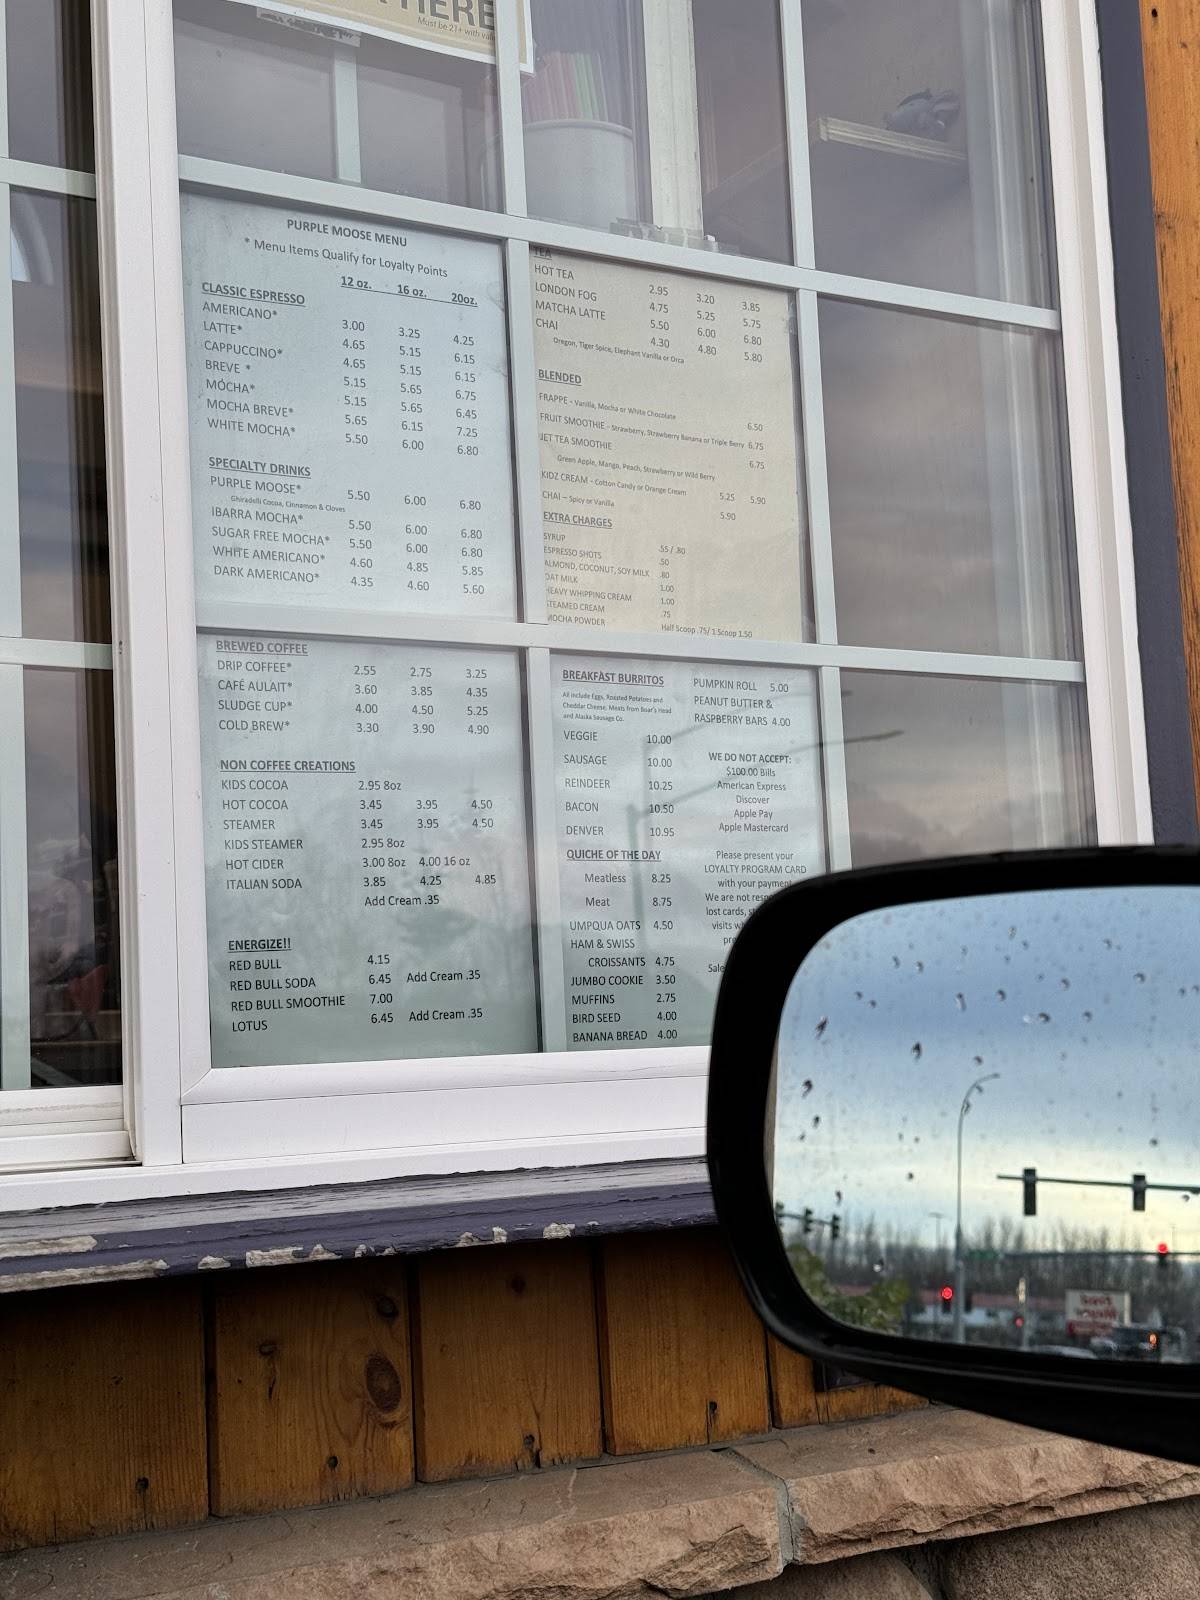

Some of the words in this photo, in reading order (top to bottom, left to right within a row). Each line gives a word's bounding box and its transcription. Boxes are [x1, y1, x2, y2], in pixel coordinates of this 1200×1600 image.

[286, 218, 329, 235] PURPLE
[330, 225, 372, 242] MOOSE
[374, 232, 407, 247] MENU
[253, 238, 286, 253] Menu
[288, 242, 319, 258] Items
[320, 247, 360, 266] Qualify
[360, 253, 377, 266] for
[378, 256, 415, 275] Loyalty
[416, 262, 448, 278] Points
[200, 281, 247, 298] CLASSIC
[249, 287, 306, 307] ESPRESSO
[339, 275, 354, 287] 12
[355, 279, 372, 290] oz.
[396, 283, 410, 295] 16
[411, 287, 427, 298] oz.
[450, 291, 478, 306] 20oz.
[533, 263, 554, 277] HOT
[555, 267, 575, 281] TEA
[648, 283, 669, 297] 2.95
[695, 292, 715, 305] 3.20
[740, 300, 761, 313] 3.85
[534, 299, 577, 316] MATCHA
[578, 306, 606, 321] LATTE
[649, 318, 670, 331] 5.50
[696, 326, 716, 339] 6.00
[742, 333, 762, 346] 6.80
[341, 318, 365, 332] 3.00
[397, 325, 421, 339] 3.25
[451, 333, 475, 347] 4.25
[552, 336, 578, 348] Oregon,
[577, 340, 594, 351] Tiger
[594, 343, 613, 354] Spice,
[613, 346, 641, 358] Elephant
[640, 350, 662, 361] Vanilla
[669, 355, 685, 364] Orca
[341, 356, 366, 370] 4.65
[398, 363, 422, 376] 5.15
[454, 370, 476, 383] 6.15
[537, 368, 582, 384] BLENDED
[538, 391, 568, 405] FRAPPE
[573, 399, 597, 410] Vanilla,
[597, 402, 619, 412] Mocha
[626, 406, 646, 416] White
[646, 409, 676, 420] Chocolate
[746, 421, 764, 432] 6.50
[206, 416, 245, 432] WHITE
[344, 432, 369, 445] 5.50
[401, 438, 424, 451] 6.00
[456, 444, 479, 456] 6.80
[208, 455, 267, 473] SPECIALTY
[269, 462, 311, 477] DRINKS
[542, 509, 571, 523] EXTRA
[571, 514, 613, 528] CHARGES
[210, 525, 250, 540] SUGAR
[252, 529, 279, 542] FREE
[348, 537, 372, 550] 5.50
[405, 541, 428, 554] 6.00
[460, 546, 483, 558] 6.80
[213, 564, 244, 578] DARK
[349, 575, 374, 588] 4.35
[406, 579, 430, 591] 4.60
[462, 583, 485, 595] 5.60
[215, 639, 264, 652] BREWED
[266, 642, 308, 654] COFFEE
[216, 659, 243, 671] DRIP
[353, 664, 377, 676] 2.55
[409, 666, 432, 678] 2.75
[465, 668, 487, 679] 3.25
[562, 668, 616, 682] BREAKFAST
[617, 672, 665, 685] BURRITOS
[692, 677, 734, 690] PUMPKIN
[735, 680, 758, 691] ROLL
[769, 682, 789, 693] 5.00
[562, 729, 598, 741] VEGGIE
[644, 733, 674, 746] 10.00
[219, 758, 247, 770] NON
[248, 759, 292, 771] COFFEE
[292, 759, 356, 771] CREATIONS
[707, 751, 723, 762] WE
[723, 751, 737, 762] DO
[738, 752, 757, 763] NOT
[757, 752, 792, 764] ACCEPT:
[725, 765, 759, 777] $100.00
[759, 767, 776, 777] Bills
[220, 778, 247, 790] KIDS
[248, 778, 289, 791] COCOA
[357, 779, 381, 791] 2.95
[382, 779, 402, 791] 8oz
[564, 777, 611, 790] REINDEER
[645, 779, 673, 791] 10.25
[735, 793, 770, 805] Discover
[717, 821, 742, 833] Apple
[742, 822, 789, 833] Mastercard
[224, 858, 250, 870] HOT
[250, 858, 285, 870] CIDER
[361, 856, 386, 868] 3.00
[386, 856, 407, 868] 8oz
[417, 855, 441, 868] 4.00
[443, 855, 457, 866] 16
[458, 857, 471, 866] oz
[565, 848, 604, 860] QUICHE
[605, 848, 619, 859] OF
[619, 848, 639, 860] THE
[641, 849, 661, 860] DAY
[703, 863, 740, 874] LOYALTY
[740, 864, 783, 874] PROGRAM
[783, 864, 807, 874] CARD
[225, 878, 269, 890] ITALIAN
[270, 877, 303, 889] SODA
[362, 875, 386, 888] 3.85
[417, 874, 443, 886] 4.25
[474, 873, 497, 885] 4.85
[584, 872, 627, 883] Meatless
[650, 872, 672, 884] 8.25
[227, 936, 291, 951] ENERGIZE!!
[228, 959, 252, 972] RED
[253, 958, 282, 970] BULL
[366, 953, 391, 965] 4.15
[587, 955, 646, 968] CROISSANTS
[654, 955, 675, 967] 4.75
[228, 979, 252, 992] RED
[254, 978, 283, 991] BULL
[283, 975, 317, 989] SODA
[367, 972, 392, 985] 6.45
[405, 970, 428, 983] Add
[429, 970, 463, 982] Cream
[465, 968, 481, 981] .35
[571, 992, 615, 1006] MUFFINS
[655, 991, 677, 1003] 2.75
[231, 1019, 268, 1033] LOTUS
[370, 1011, 394, 1024] 6.45
[572, 1030, 614, 1045] BANANA
[615, 1029, 648, 1041] BREAD
[656, 1028, 678, 1040] 4.00
